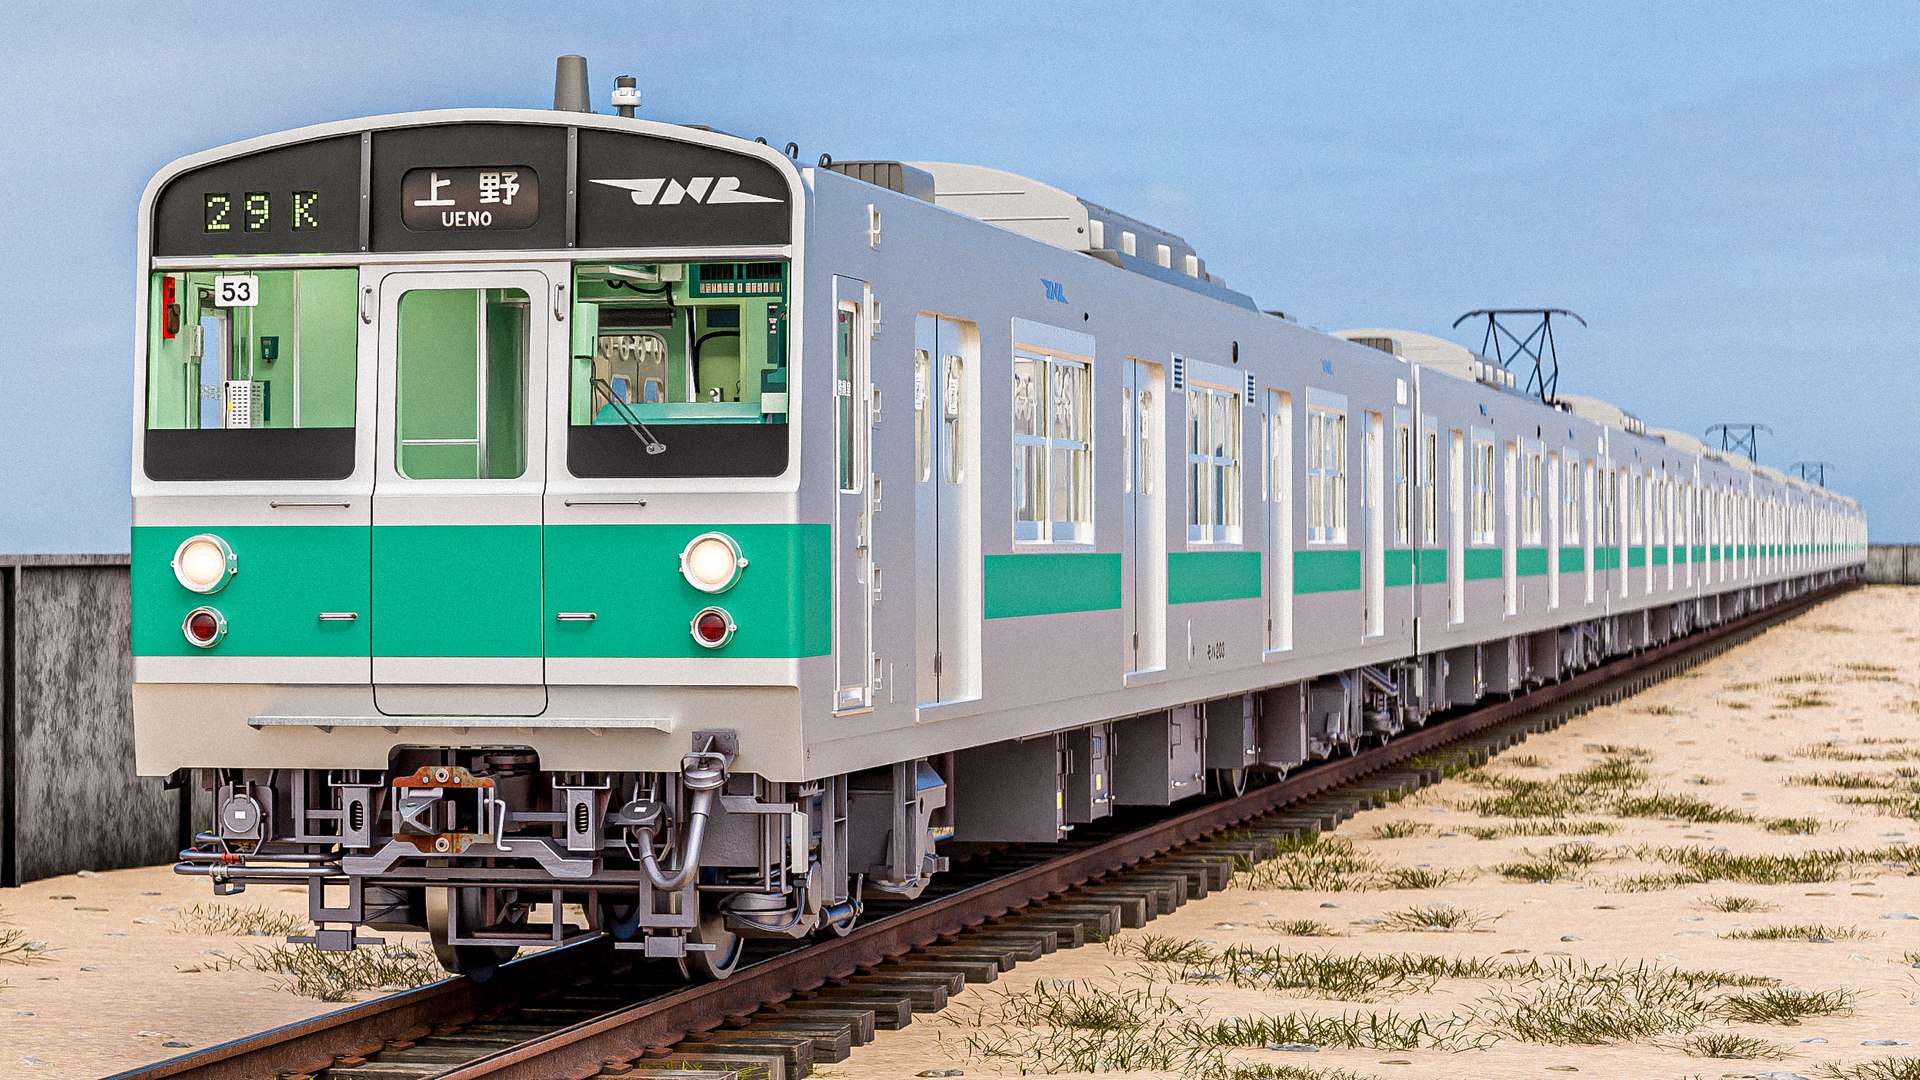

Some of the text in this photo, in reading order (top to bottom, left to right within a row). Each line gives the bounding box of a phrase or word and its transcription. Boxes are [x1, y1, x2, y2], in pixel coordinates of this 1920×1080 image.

[413, 171, 520, 206] 上野
[441, 211, 492, 227] UENO
[221, 282, 251, 302] 53
